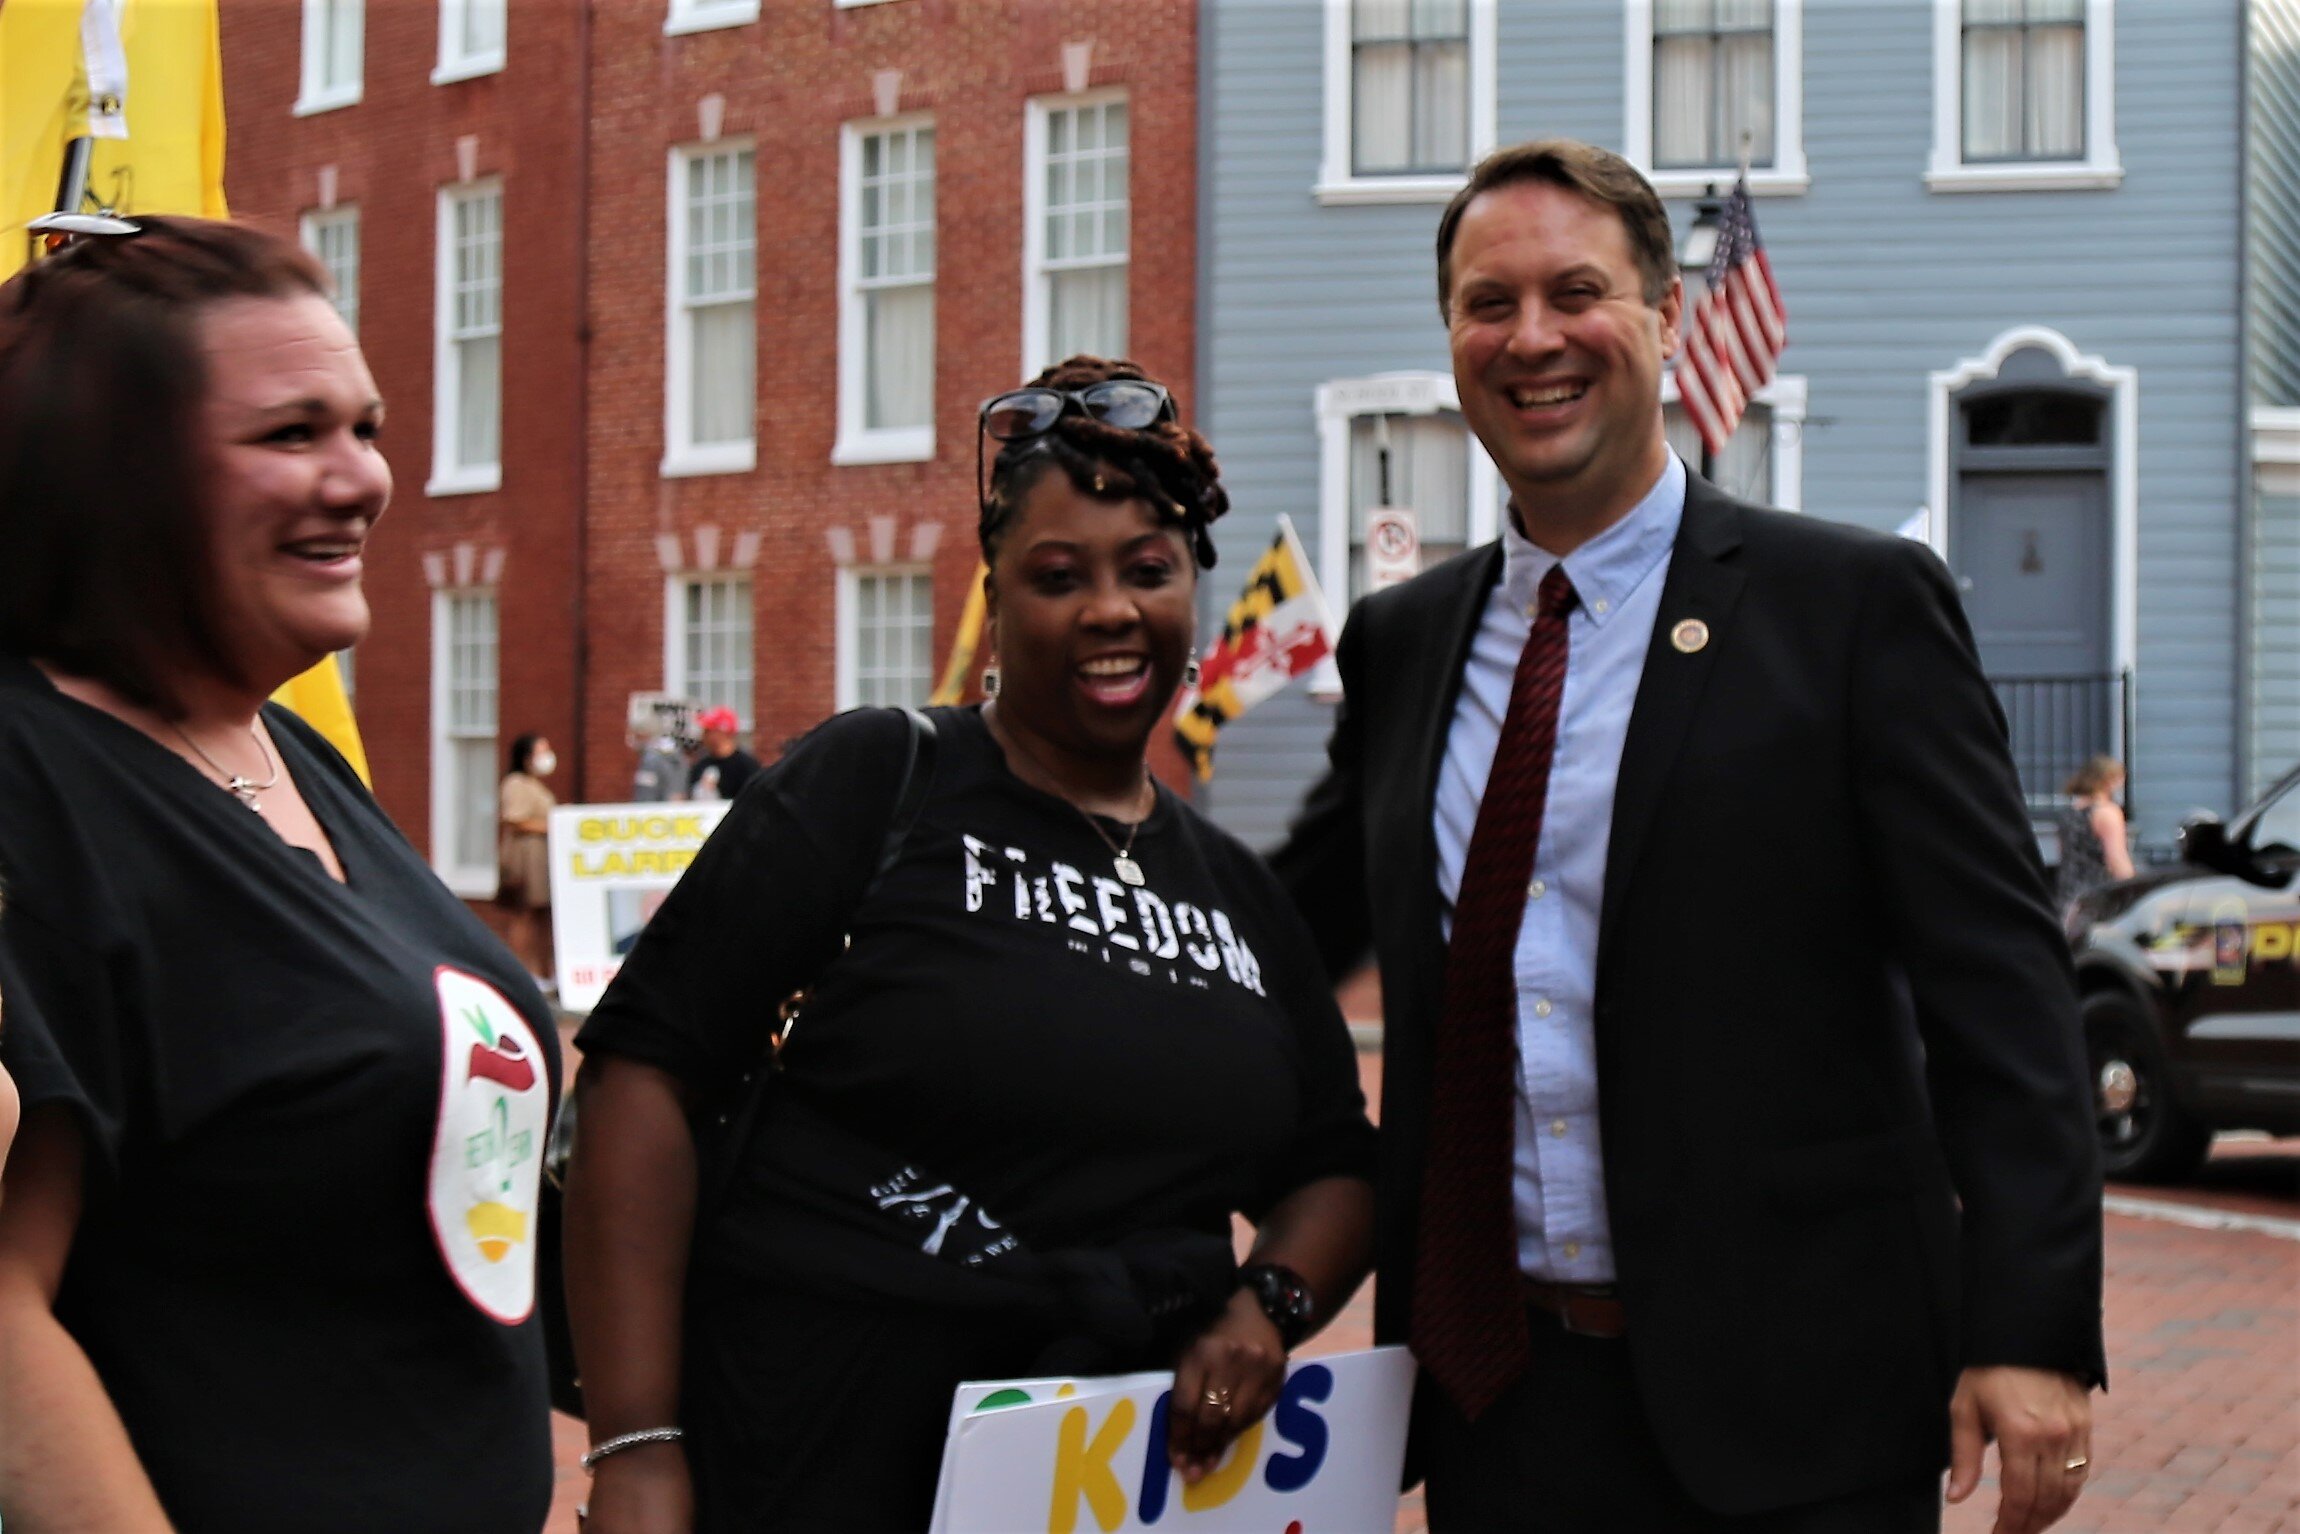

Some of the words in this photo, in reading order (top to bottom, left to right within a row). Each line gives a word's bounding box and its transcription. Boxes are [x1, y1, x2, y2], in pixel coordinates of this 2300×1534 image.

[579, 816, 703, 842] SUCK
[572, 850, 696, 877] LARR
[962, 833, 1267, 998] FREEDOM
[2254, 922, 2300, 960] P
